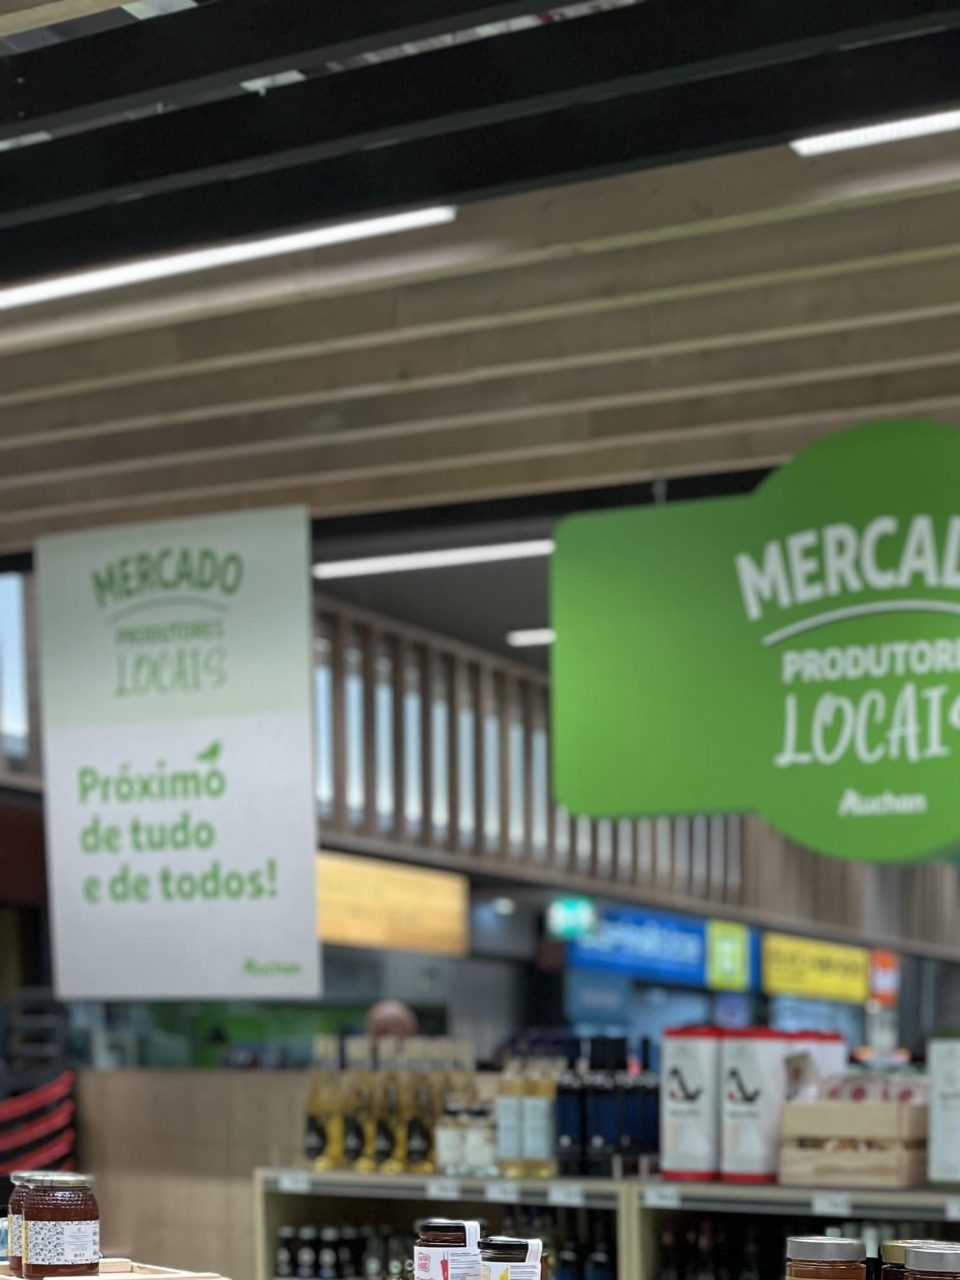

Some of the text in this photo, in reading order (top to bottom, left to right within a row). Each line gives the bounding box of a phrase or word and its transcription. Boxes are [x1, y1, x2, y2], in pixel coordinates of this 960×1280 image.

[92, 547, 244, 607] MERCADO
[113, 645, 228, 697] LOCAIS
[77, 758, 227, 804] Próximo
[837, 788, 927, 817] Auchan
[80, 813, 215, 854] de tudo
[83, 858, 278, 903] e de todos!
